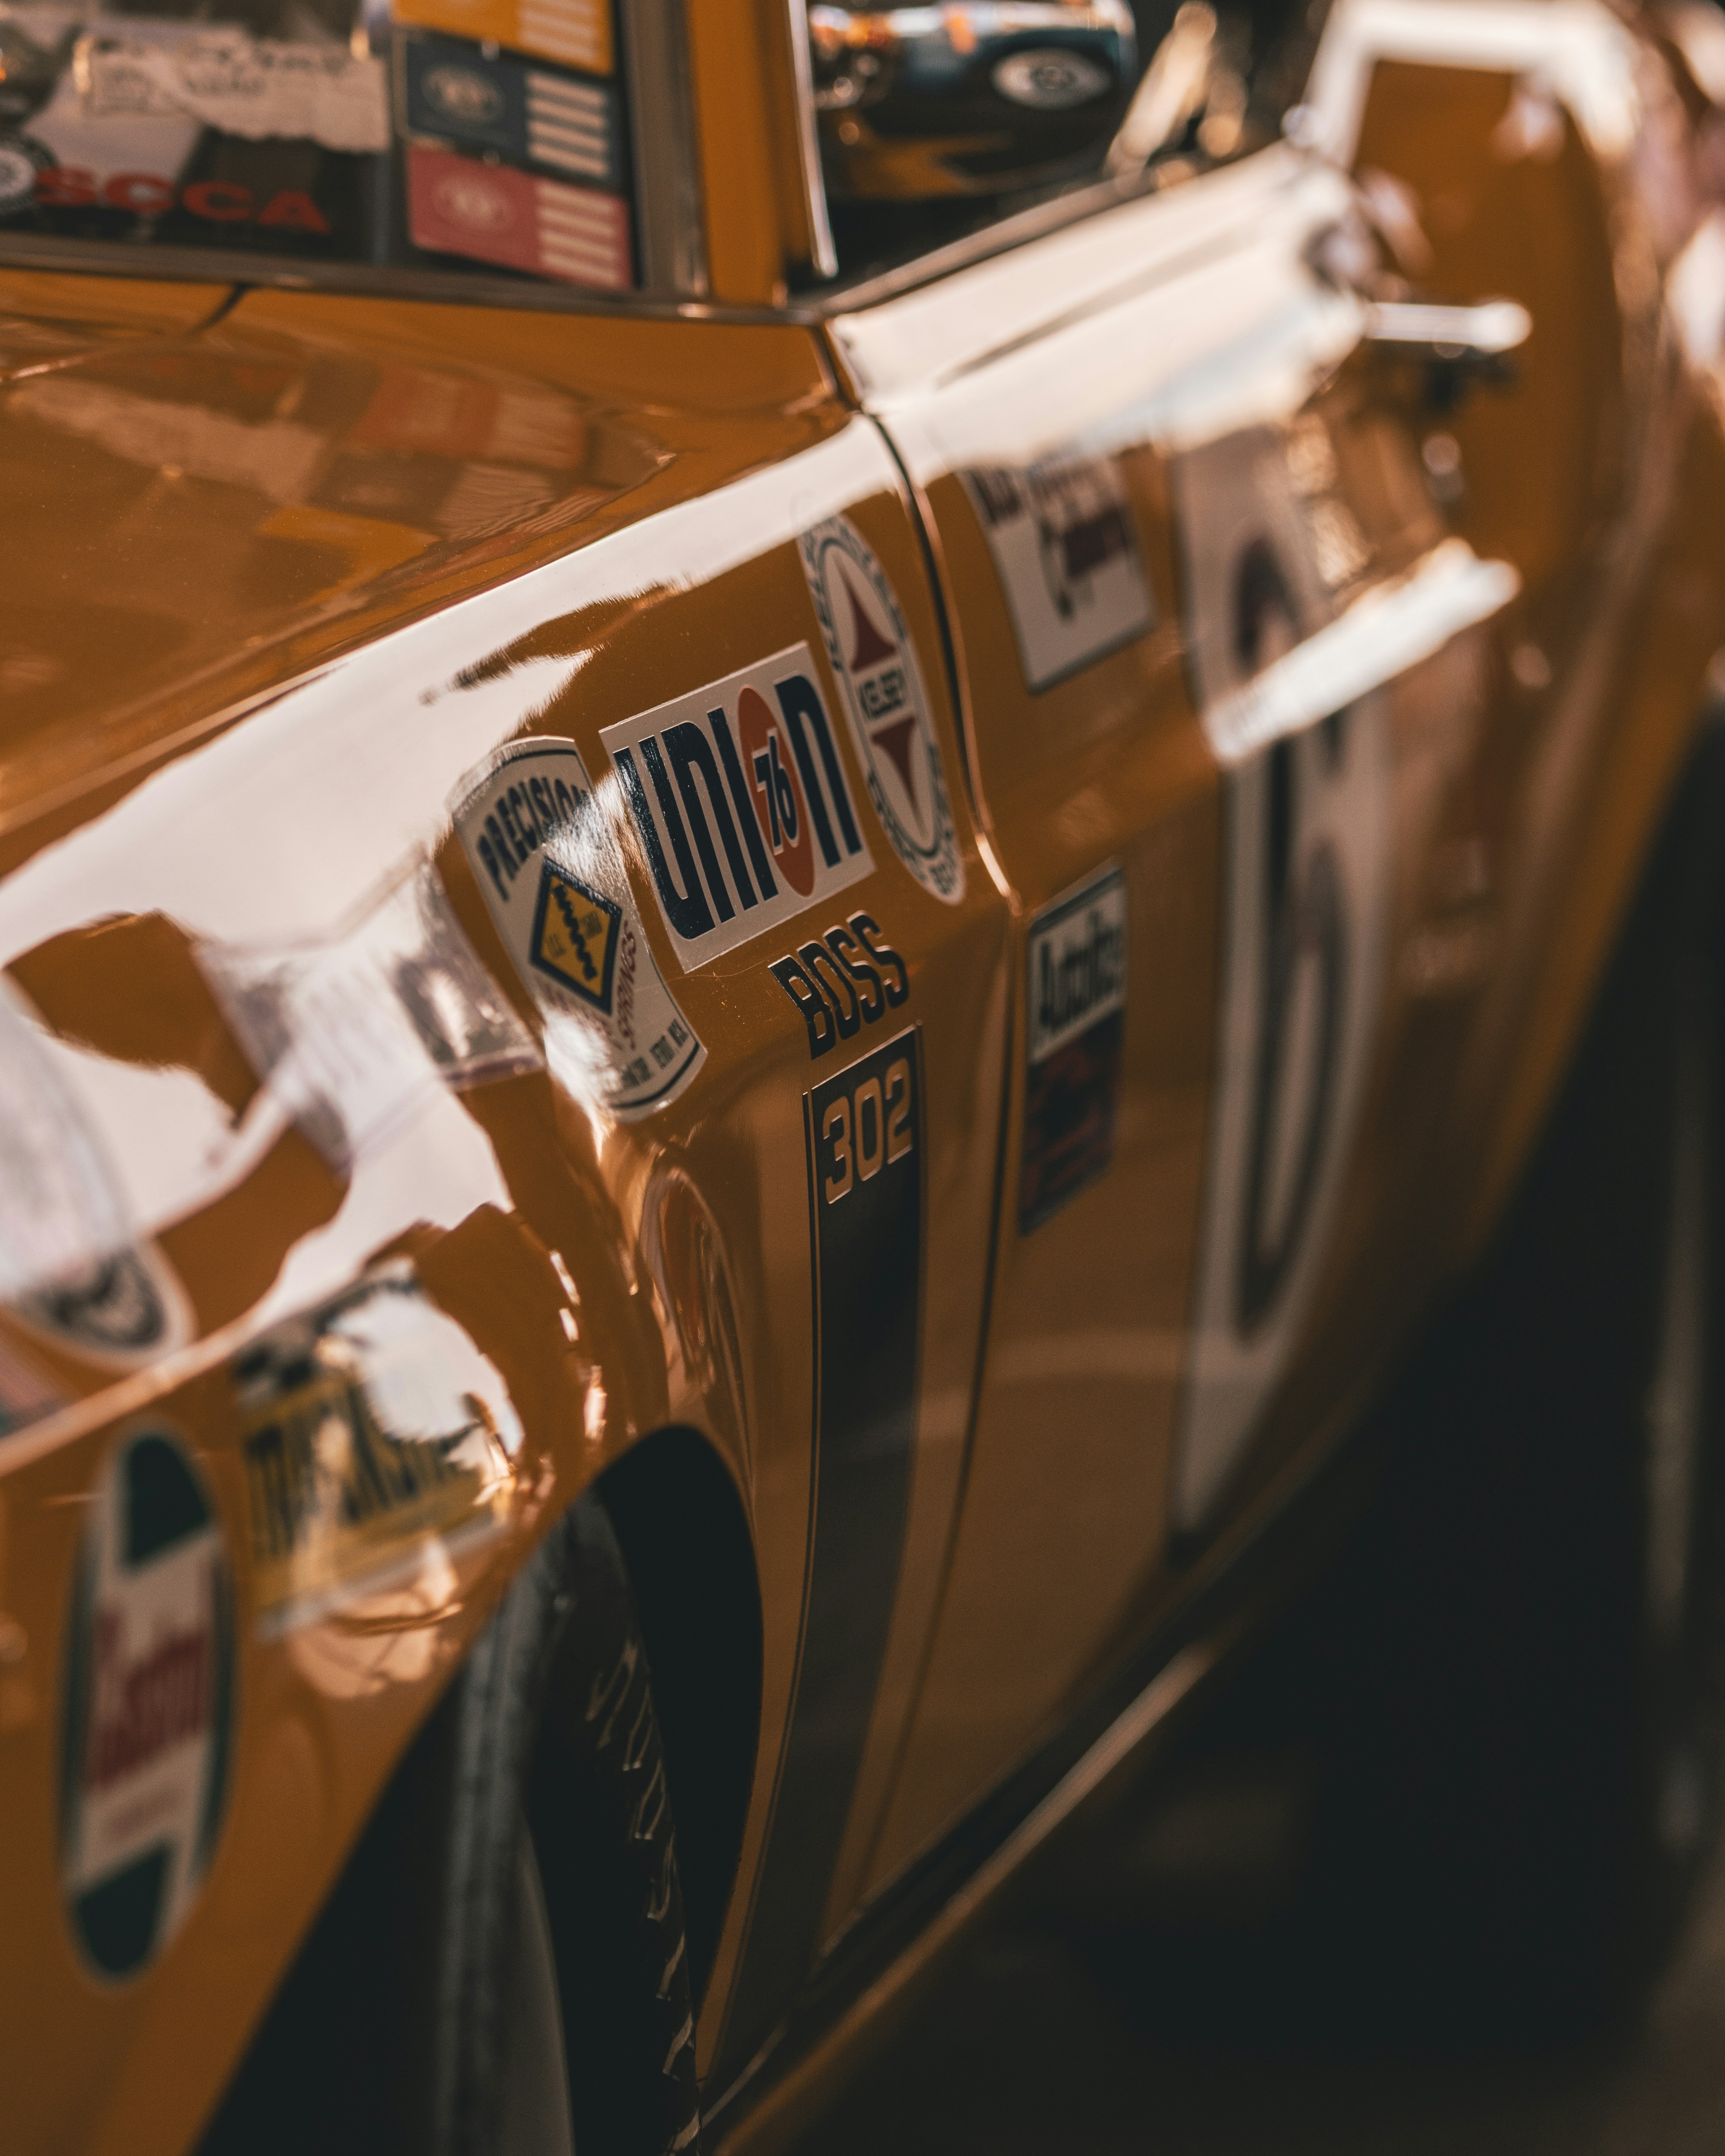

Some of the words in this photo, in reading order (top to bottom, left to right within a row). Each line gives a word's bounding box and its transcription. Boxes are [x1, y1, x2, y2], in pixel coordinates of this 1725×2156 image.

[613, 675, 862, 940] UNION
[752, 729, 799, 854] 76
[617, 920, 637, 1051] SPRINGS
[768, 910, 909, 1060] BOSS
[822, 1058, 913, 1204] 302
